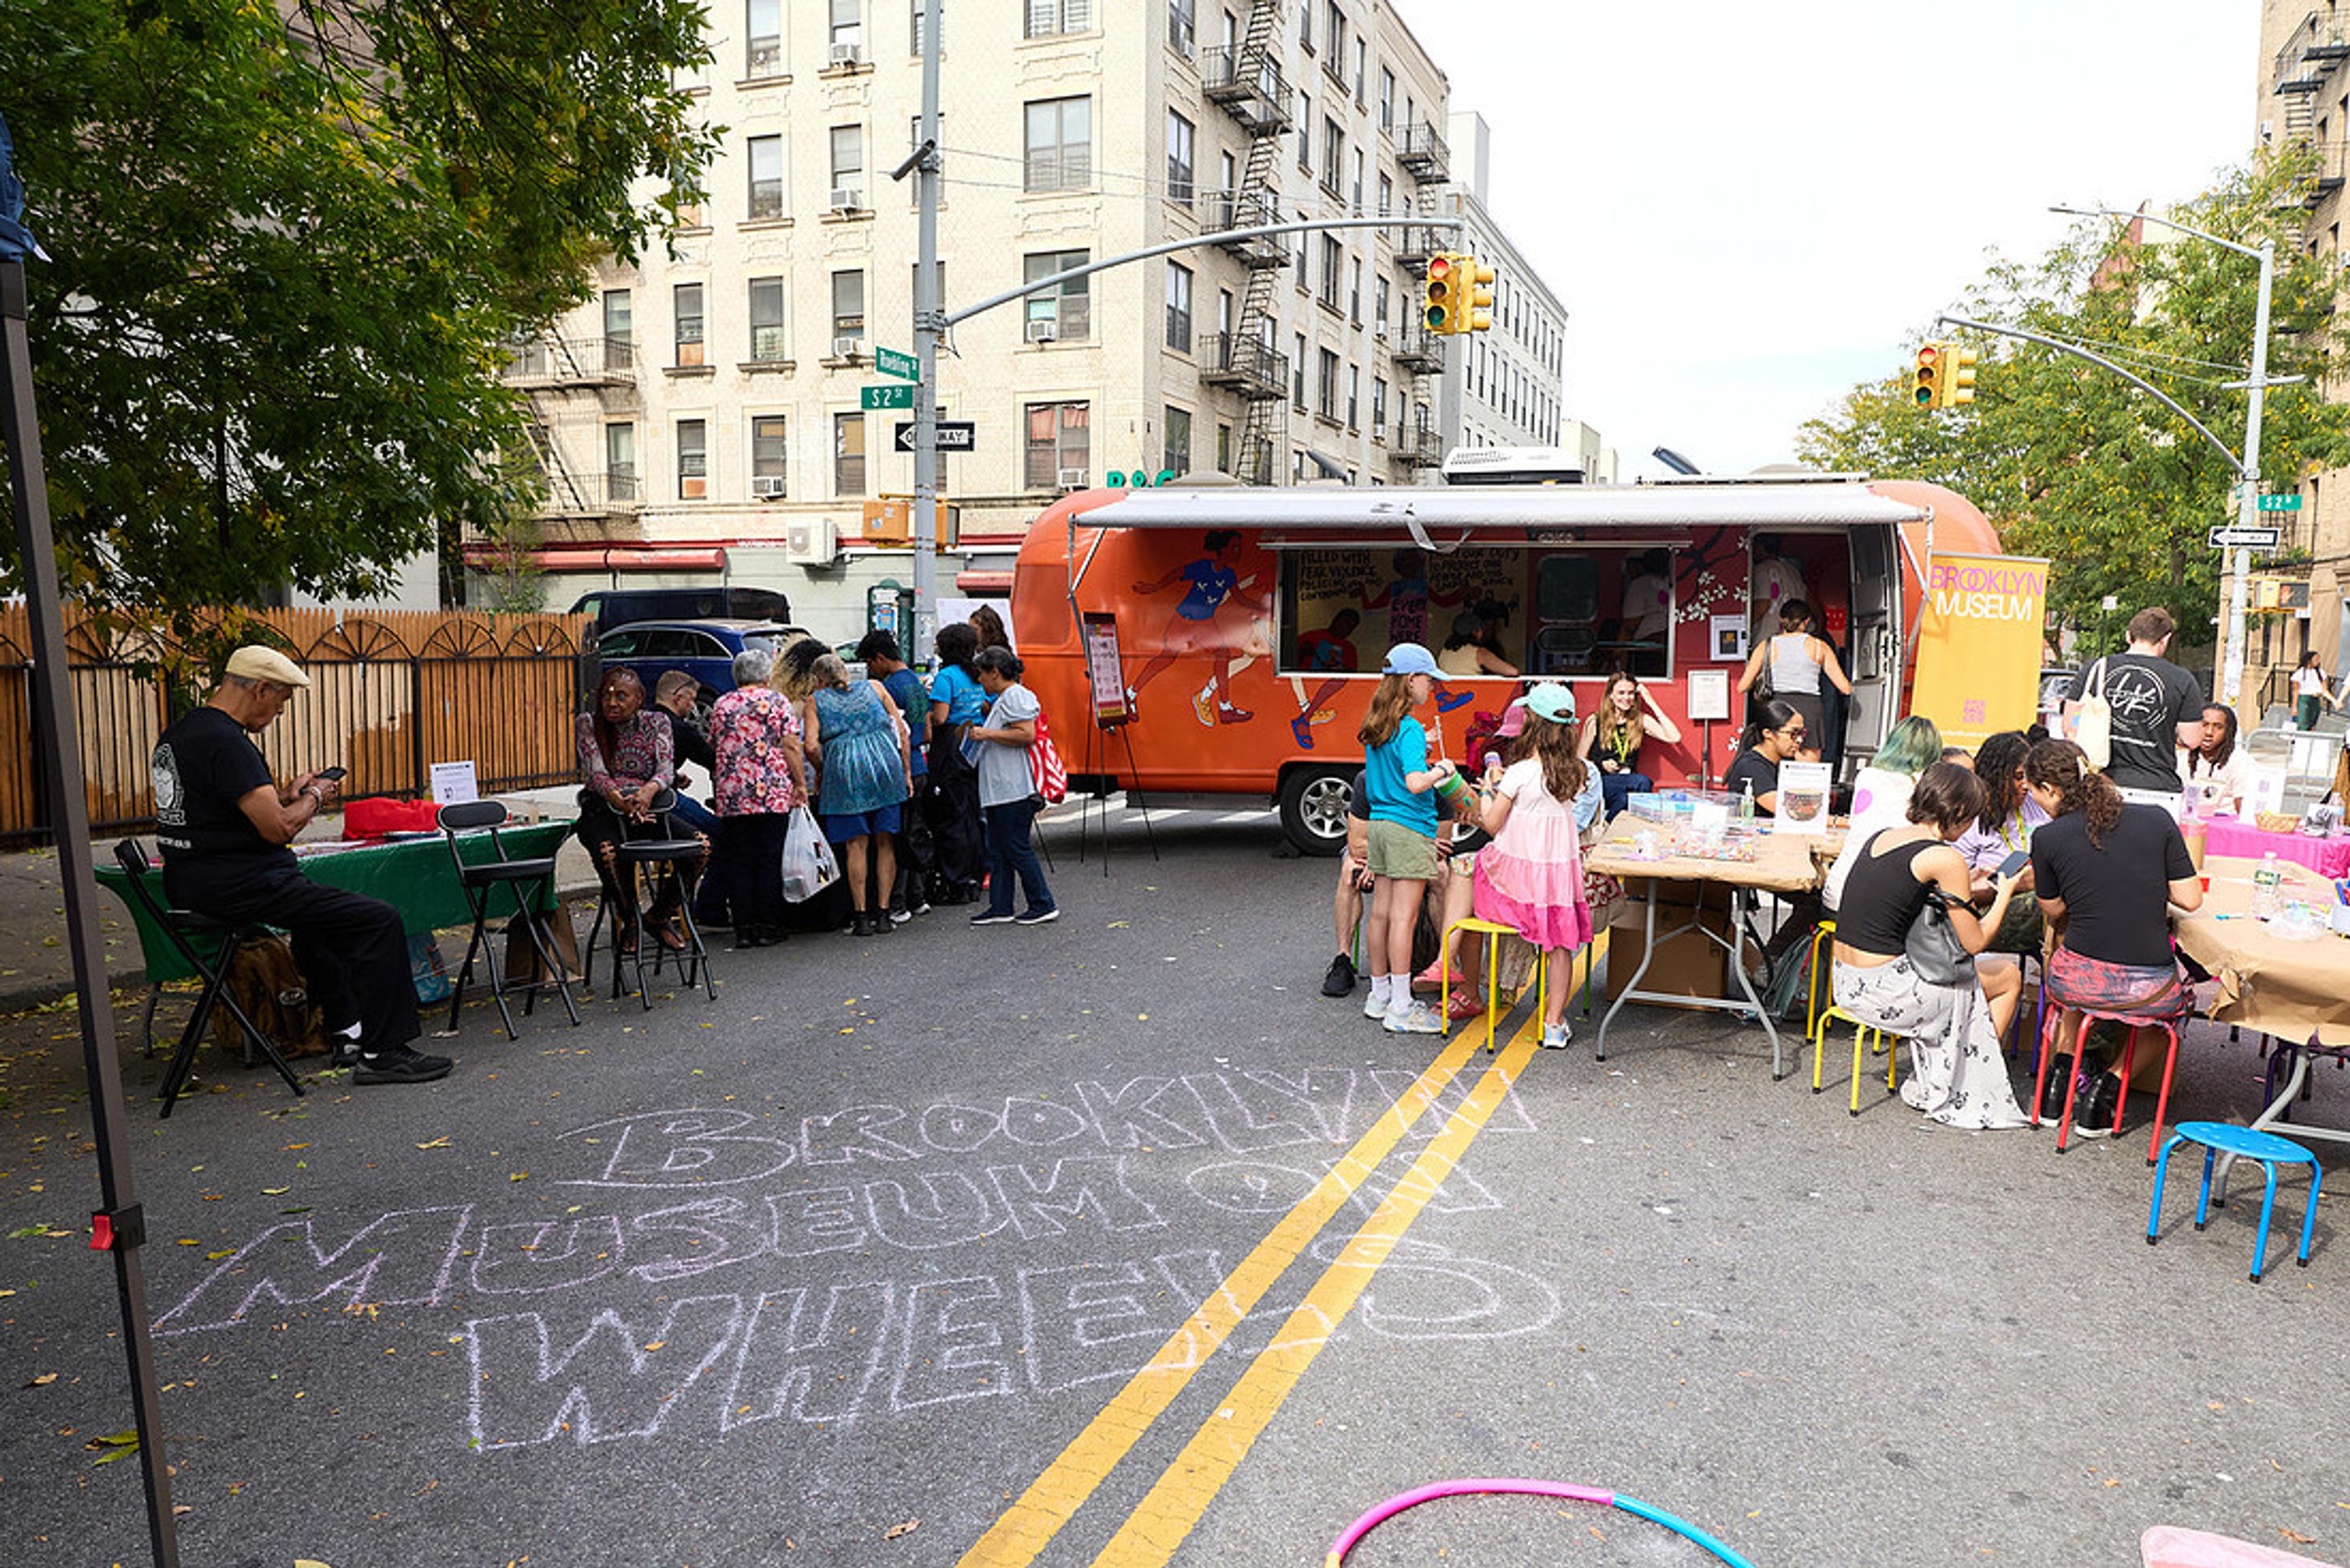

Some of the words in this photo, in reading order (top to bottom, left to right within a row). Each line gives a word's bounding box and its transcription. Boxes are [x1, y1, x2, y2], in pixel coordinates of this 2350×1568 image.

[872, 389, 879, 407] S
[884, 389, 892, 407] 2
[2275, 496, 2283, 509] 2
[1931, 565, 2043, 596] BROOKLYN
[1935, 591, 2032, 621] MUSEUM
[556, 1069, 1538, 1189] BROOKLYN
[149, 1155, 1167, 1337] MUSEUM
[1185, 1151, 1504, 1217] ON
[463, 1232, 1562, 1454] WHEELS
